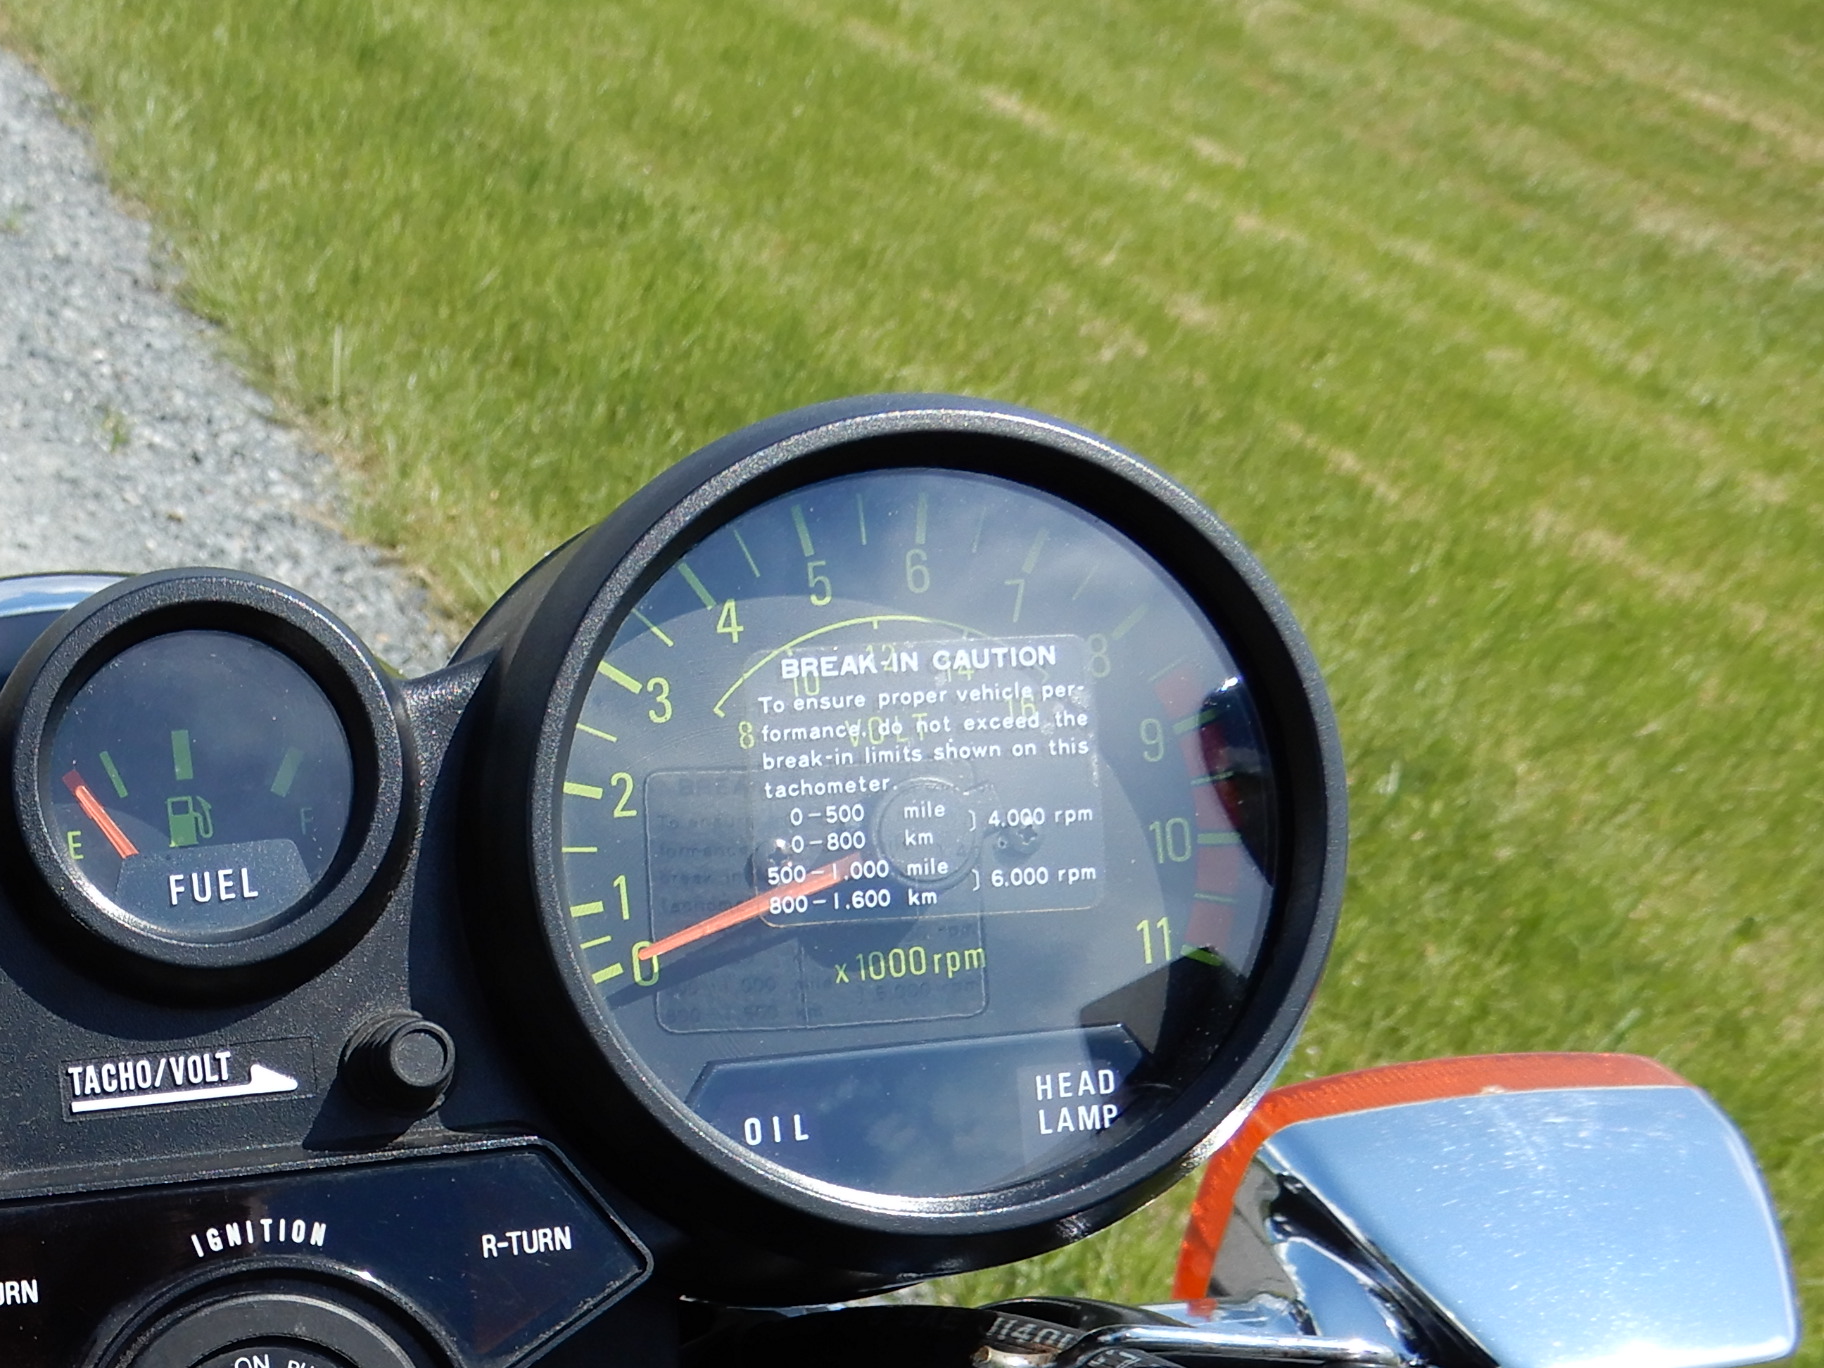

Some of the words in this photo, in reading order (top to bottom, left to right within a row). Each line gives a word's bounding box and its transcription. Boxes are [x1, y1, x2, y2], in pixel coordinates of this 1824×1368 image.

[809, 562, 833, 607] 5
[906, 548, 931, 594] 6
[1005, 580, 1029, 622] 7
[716, 600, 744, 643] 4
[781, 652, 919, 679] BREAK-IN
[932, 646, 1056, 671] CAUTION
[1088, 633, 1112, 677] 8
[646, 678, 673, 723] 3
[757, 696, 785, 715] To
[793, 694, 866, 712] ensure
[879, 690, 949, 711] proper
[956, 682, 1033, 702] vehicle
[1041, 683, 1085, 702] per-
[738, 721, 755, 749] 8
[878, 719, 903, 736] do
[916, 715, 951, 734] not
[963, 712, 1040, 731] exceed
[1055, 710, 1088, 728] the
[762, 750, 854, 770] break-in
[865, 746, 923, 765] limits
[933, 742, 1001, 761] shown
[1012, 740, 1036, 757] on
[1049, 737, 1089, 755] this
[1140, 718, 1165, 762] 9
[611, 772, 637, 817] 2
[765, 777, 898, 798] tachometer.
[299, 807, 315, 836] F
[903, 801, 946, 820] mile
[1054, 807, 1093, 825] rpm
[66, 831, 84, 861] E
[904, 830, 934, 846] km
[1149, 817, 1191, 864] 10
[168, 868, 259, 906] FUEL
[906, 858, 949, 876] mile
[1057, 865, 1097, 883] rpm
[613, 875, 630, 920] 1
[907, 888, 938, 907] km
[1136, 917, 1171, 966] 11
[633, 941, 660, 987] 0
[67, 1052, 232, 1098] TACHO/VOLT
[1036, 1069, 1116, 1101] HEAD
[744, 1115, 810, 1147] OIL
[1038, 1103, 1118, 1135] LAMP
[191, 1218, 327, 1258] IGNITION
[481, 1226, 572, 1258] R-TURN
